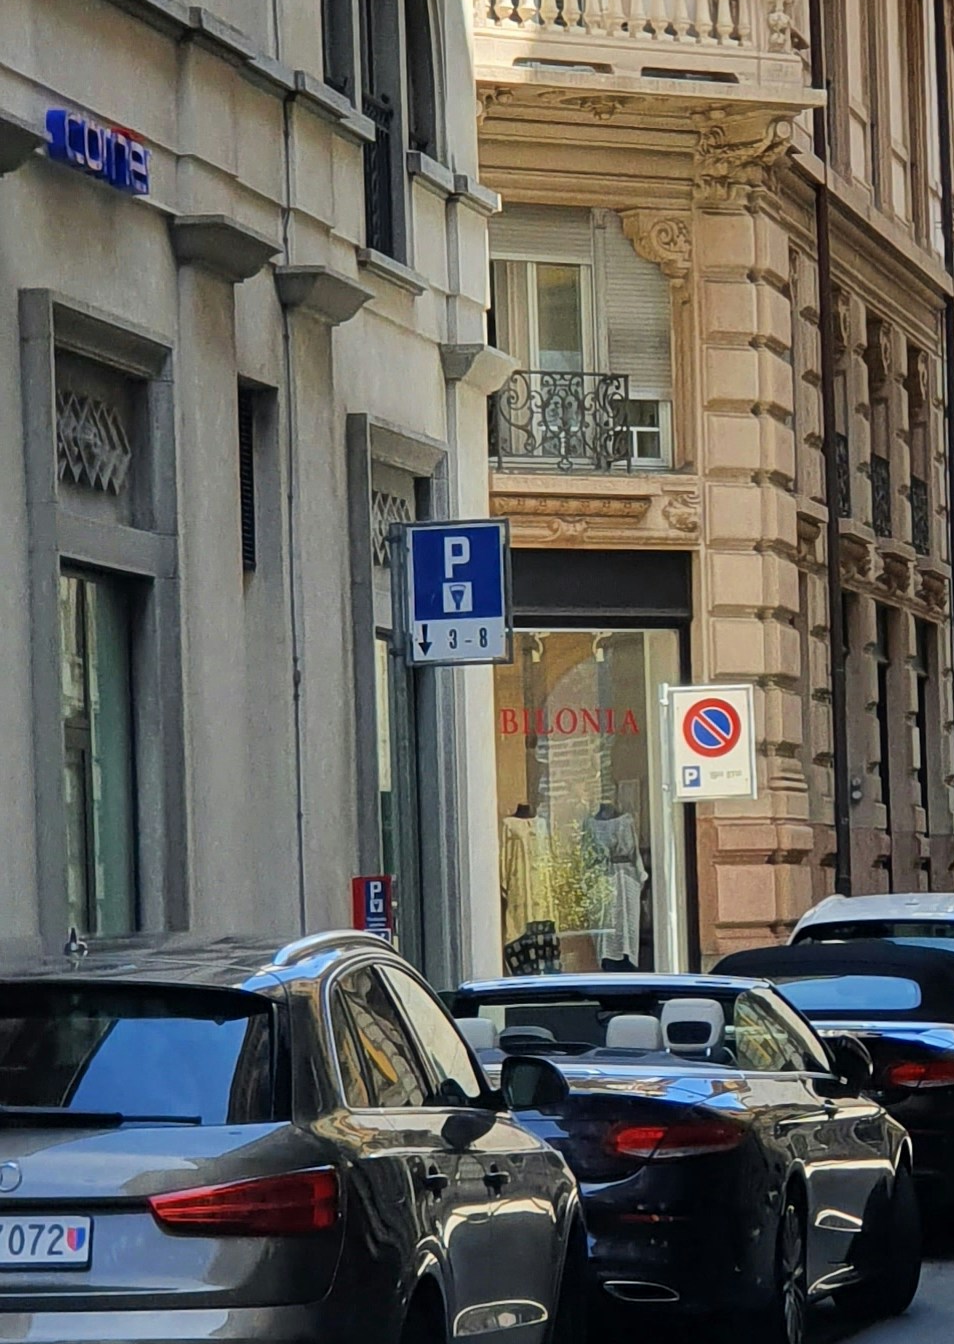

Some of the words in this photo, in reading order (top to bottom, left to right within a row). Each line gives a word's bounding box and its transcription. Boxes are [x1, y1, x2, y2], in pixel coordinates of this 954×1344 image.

[444, 536, 470, 579] P
[448, 629, 458, 649] 3
[479, 627, 488, 648] 8
[500, 707, 640, 735] BILONIA
[684, 769, 698, 785] P
[370, 881, 382, 900] P
[0, 1224, 64, 1256] 072
